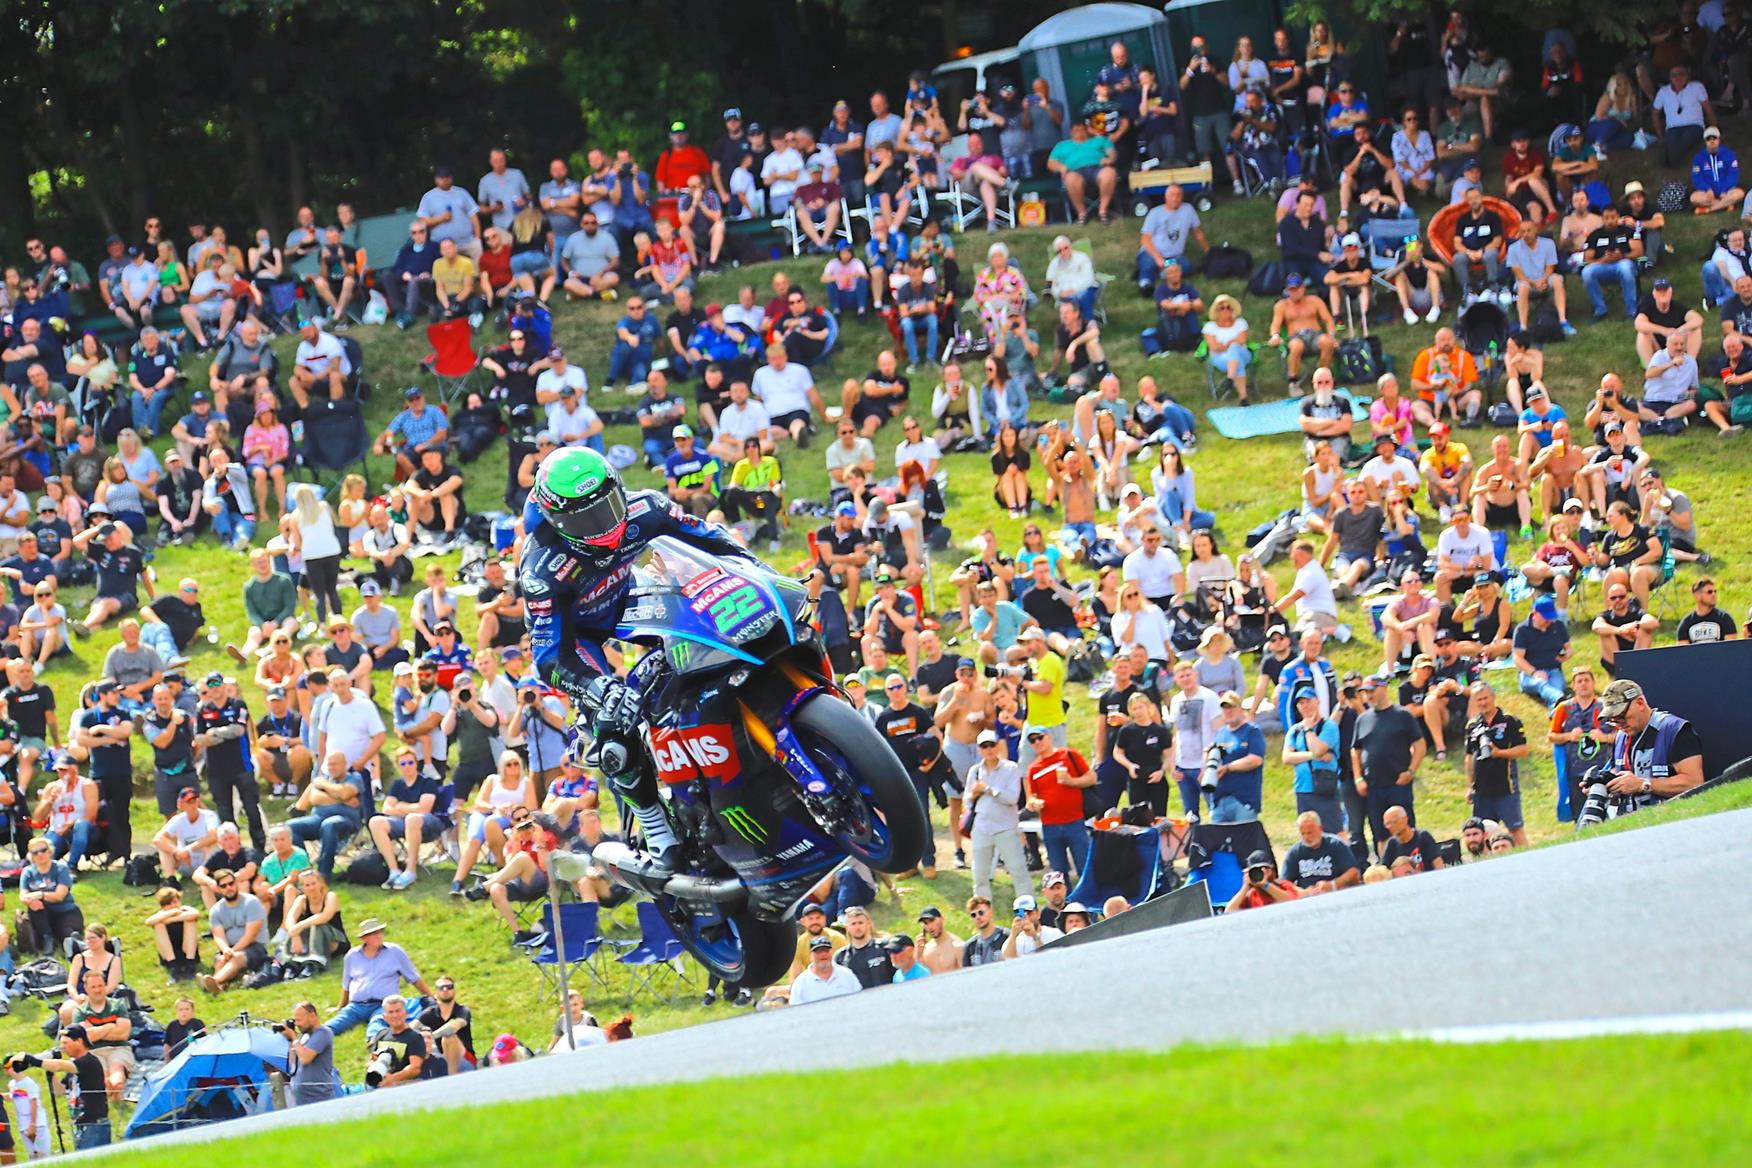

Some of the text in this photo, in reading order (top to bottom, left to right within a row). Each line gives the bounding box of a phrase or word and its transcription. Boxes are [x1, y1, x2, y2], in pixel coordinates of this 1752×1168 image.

[576, 478, 597, 493] SHOEI
[692, 577, 746, 613] McAMS
[709, 585, 765, 634] 22
[732, 610, 779, 643] MONSTER
[776, 838, 815, 861] YAMAHA
